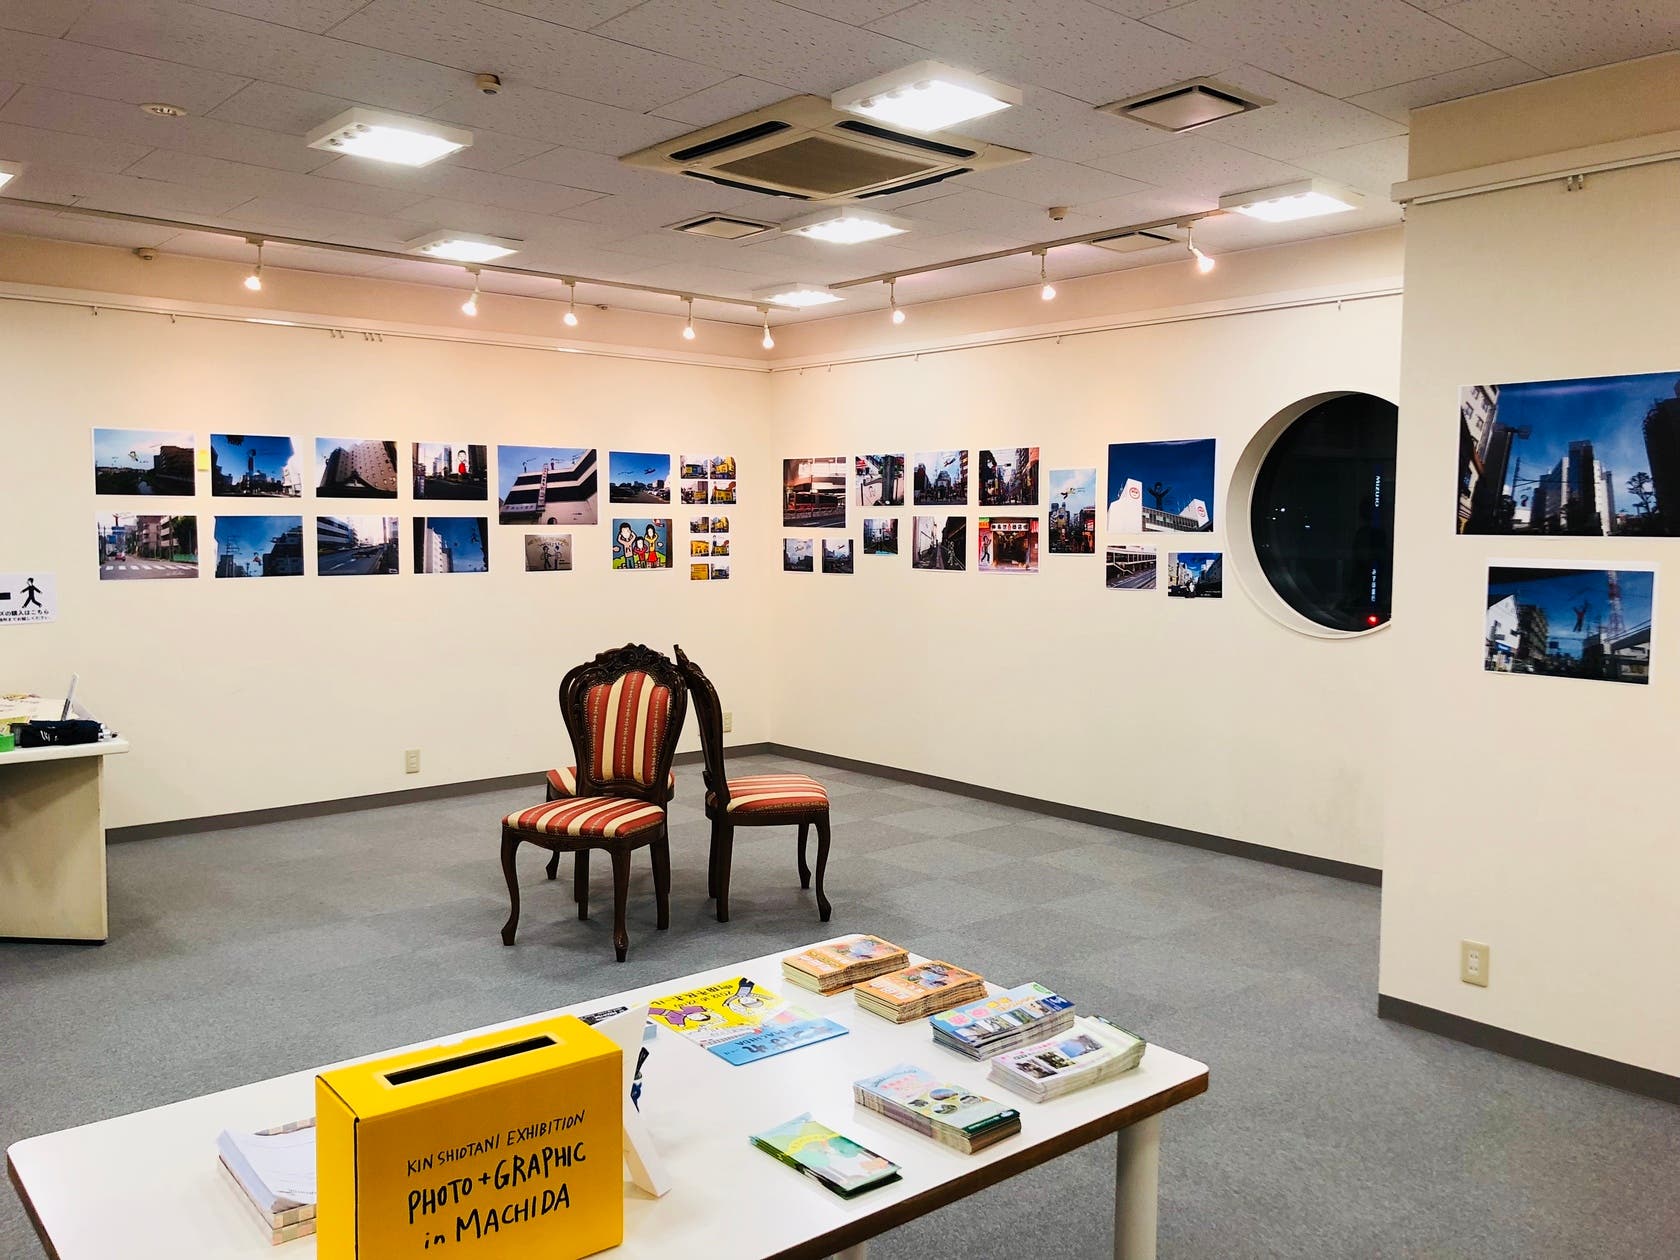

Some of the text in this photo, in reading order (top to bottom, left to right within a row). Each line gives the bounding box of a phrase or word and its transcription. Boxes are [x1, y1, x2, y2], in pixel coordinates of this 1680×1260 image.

[408, 1110, 585, 1177] KIN SHIOTANI EXHIBITION
[425, 1183, 570, 1249] in MACHIDA
